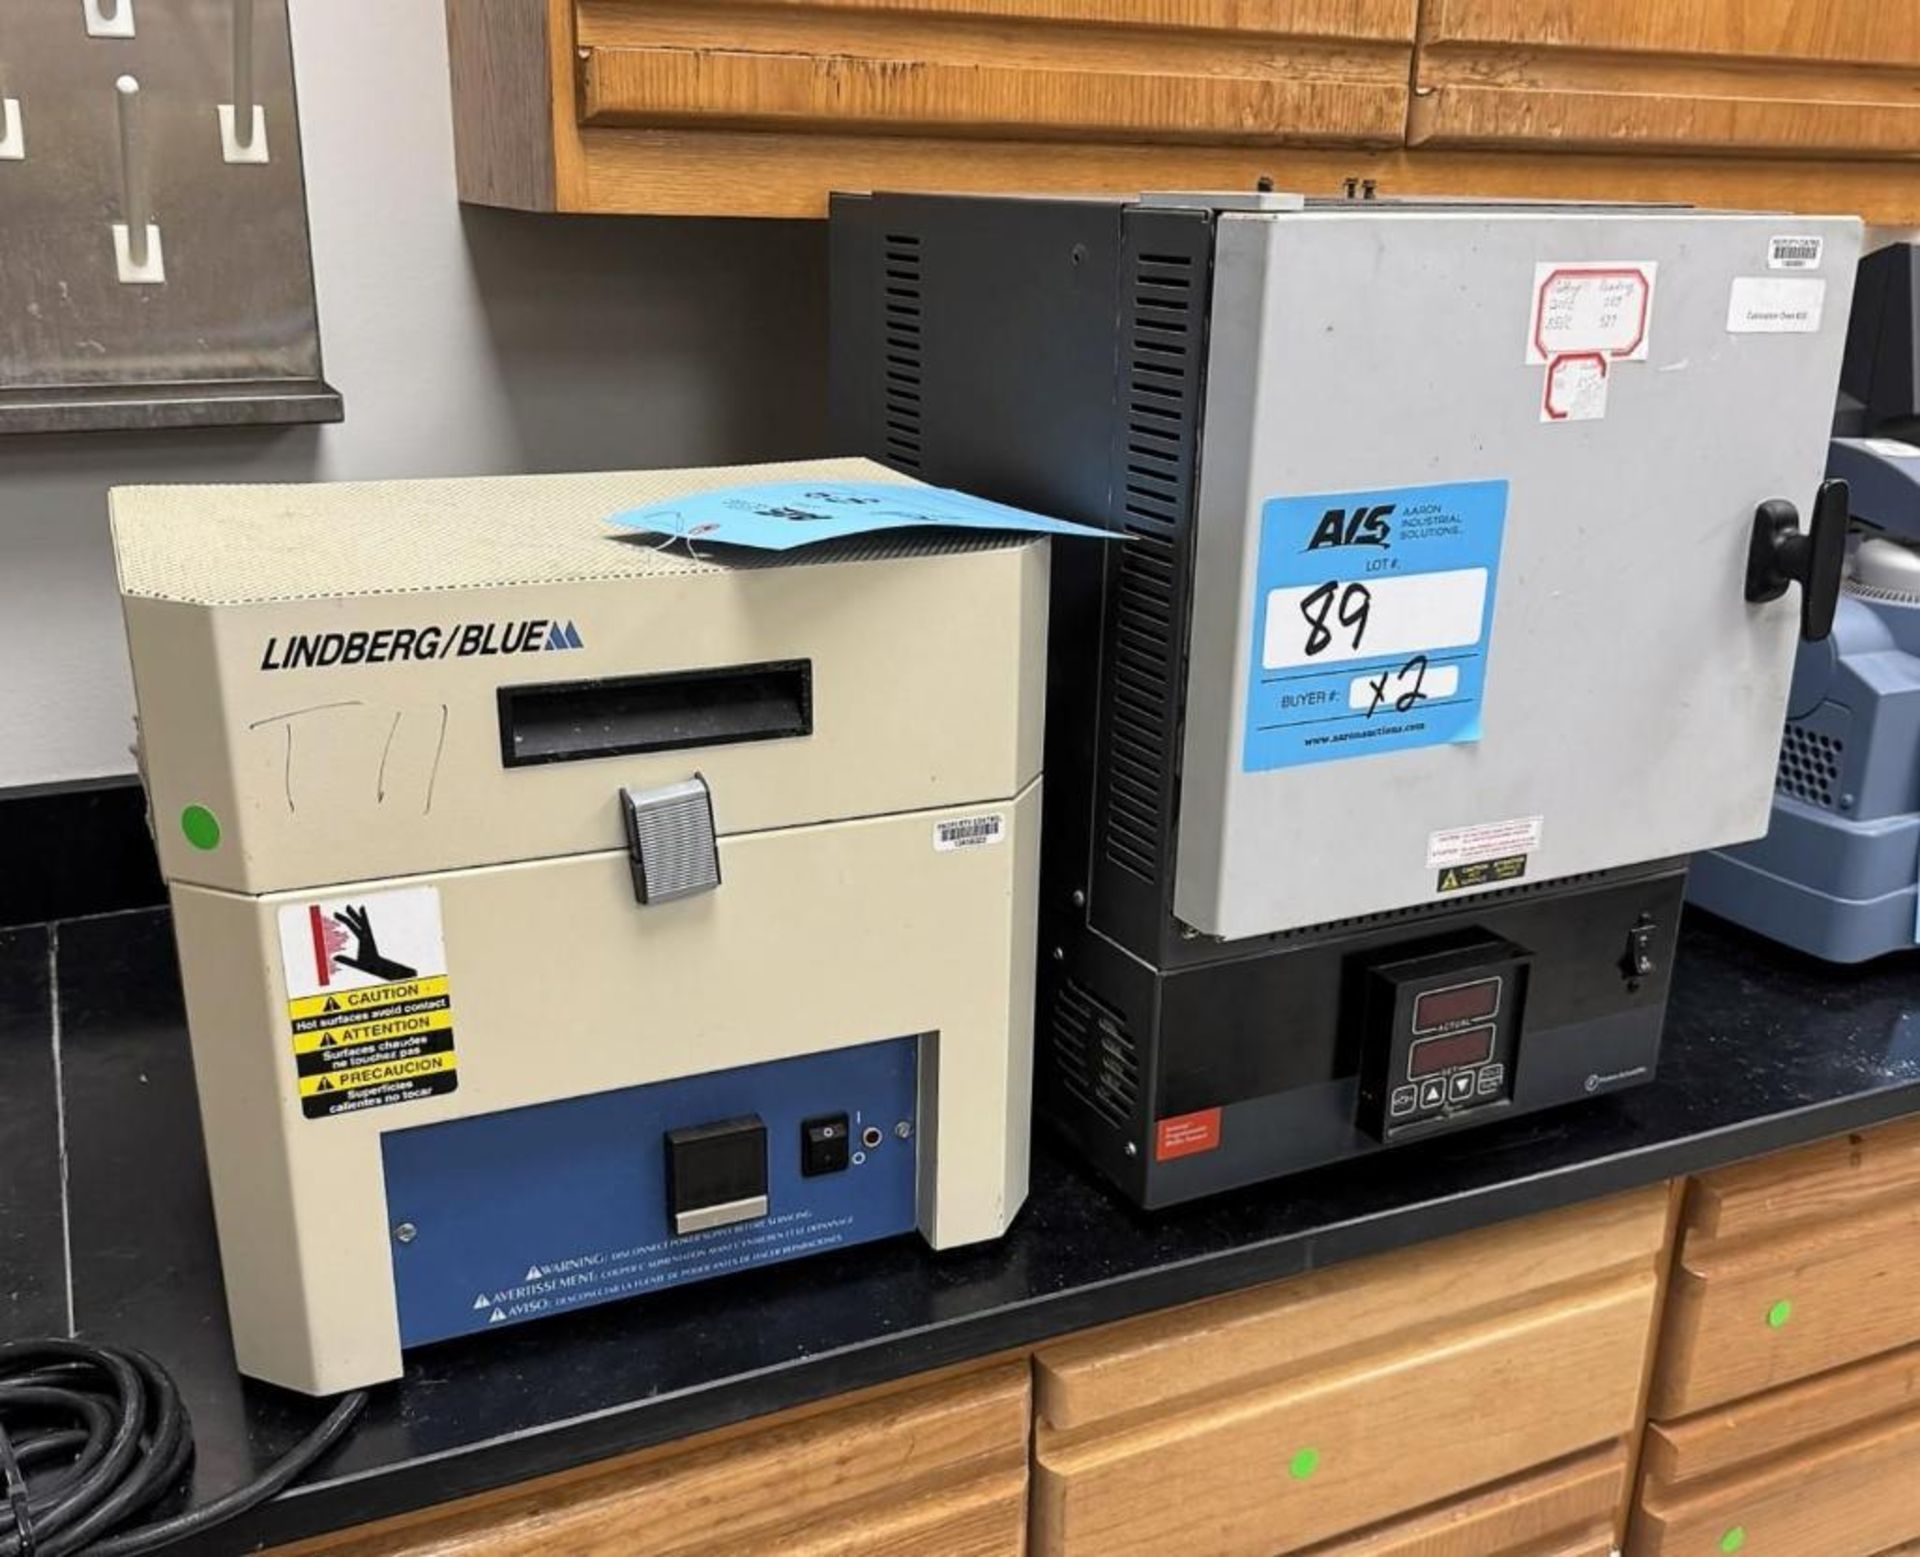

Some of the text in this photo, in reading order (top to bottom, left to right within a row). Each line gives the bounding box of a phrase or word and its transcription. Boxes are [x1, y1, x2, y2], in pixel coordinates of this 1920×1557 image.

[1401, 512, 1462, 527] INDUSTRIAL
[1402, 504, 1442, 516] AARON
[1304, 503, 1397, 552] AIS
[1366, 559, 1390, 572] LOT
[1300, 580, 1371, 656] 89
[1281, 691, 1326, 709] BUYER
[348, 984, 419, 1007] CAUTION
[296, 998, 447, 1031] Hot surfaces avoid contact
[342, 1016, 430, 1042] ATTENTION
[322, 1036, 428, 1061] Surfaces chaudes
[332, 1047, 421, 1069] ne touchez pas
[339, 1057, 443, 1085] PRECAUCION
[329, 1087, 433, 1113] calientes no tocar
[347, 1080, 414, 1100] Superficies
